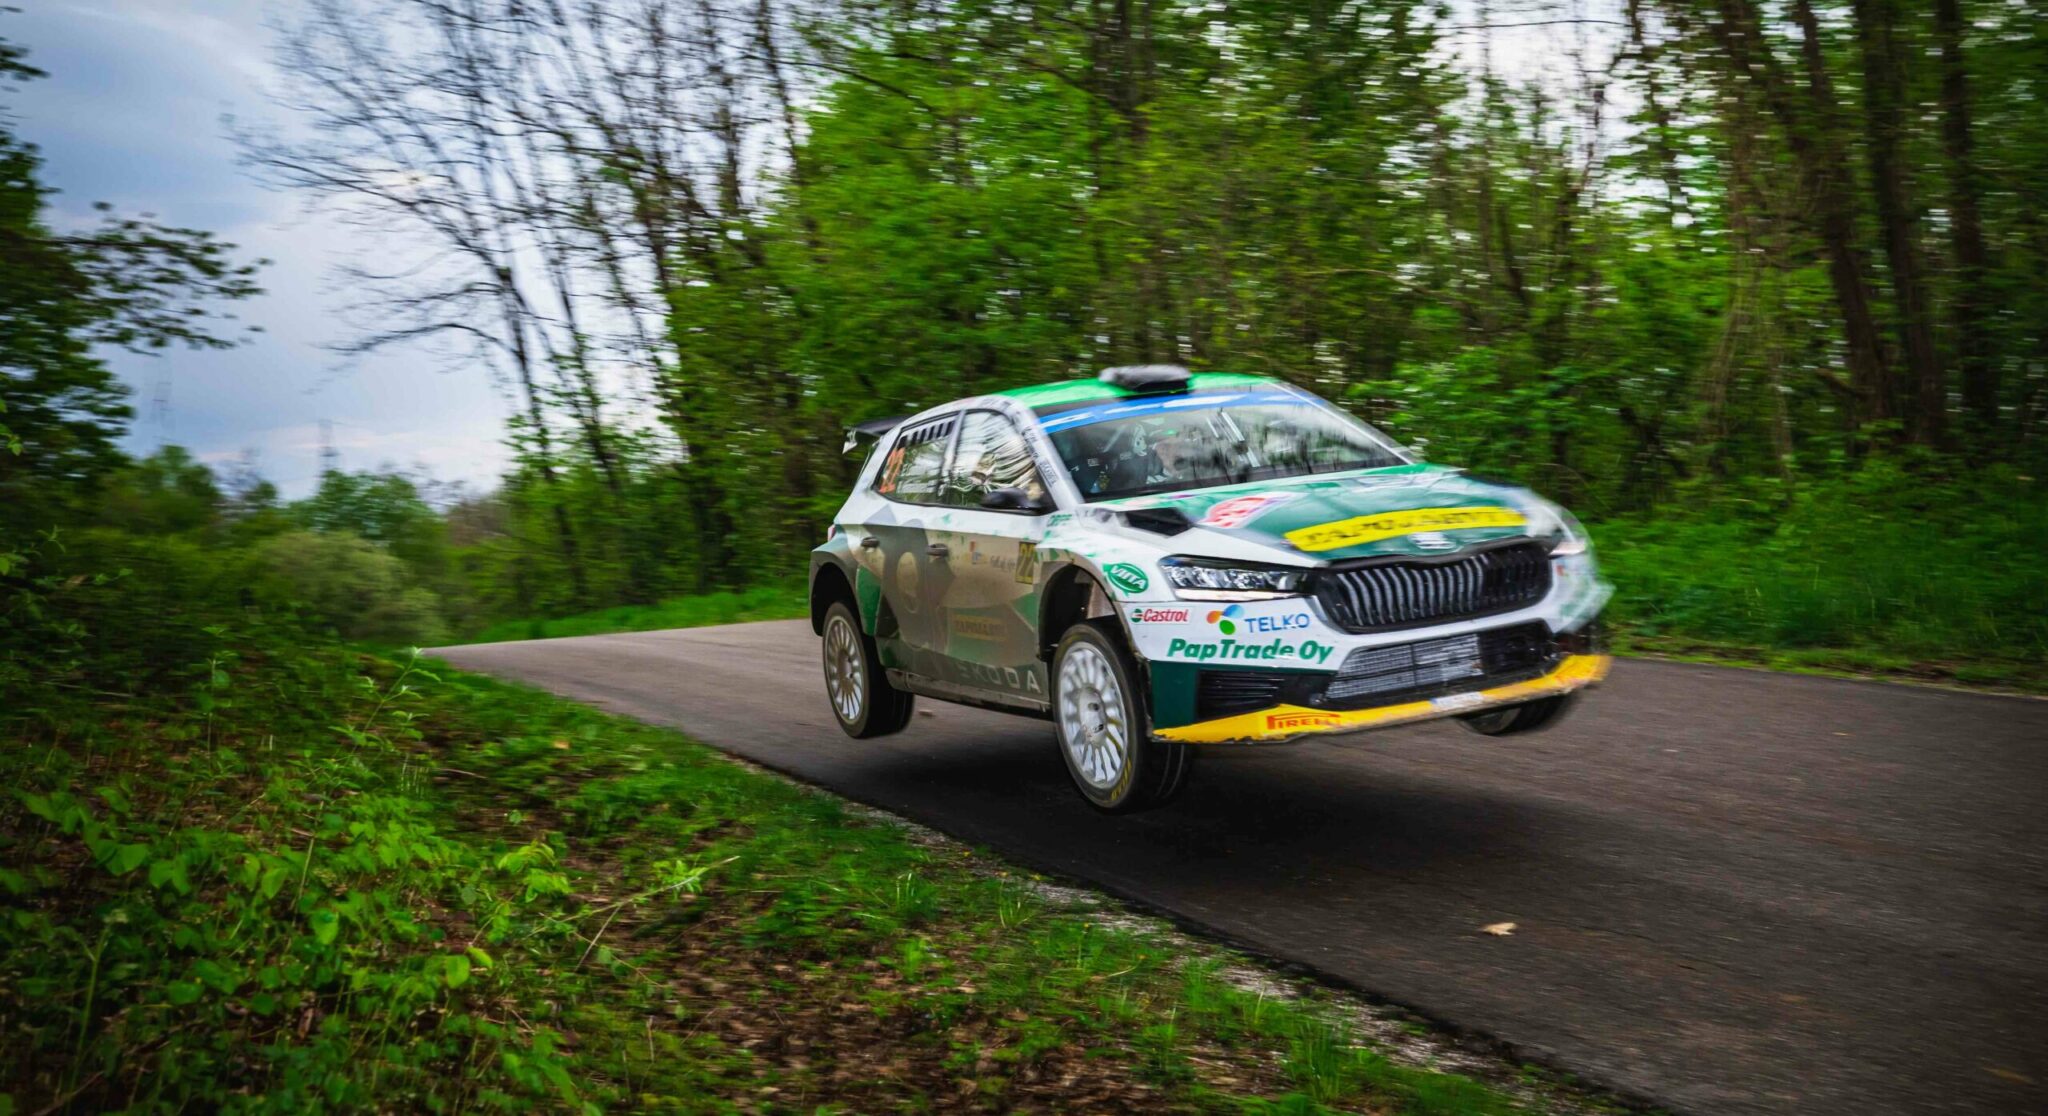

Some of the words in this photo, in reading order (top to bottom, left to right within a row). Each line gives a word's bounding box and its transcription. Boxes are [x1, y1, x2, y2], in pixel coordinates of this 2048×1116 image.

[1144, 608, 1188, 622] Castrol
[1244, 613, 1310, 633] TELKO
[1167, 638, 1295, 661] PapTrade
[1299, 640, 1334, 664] Oy
[1266, 712, 1342, 730] PIREL
